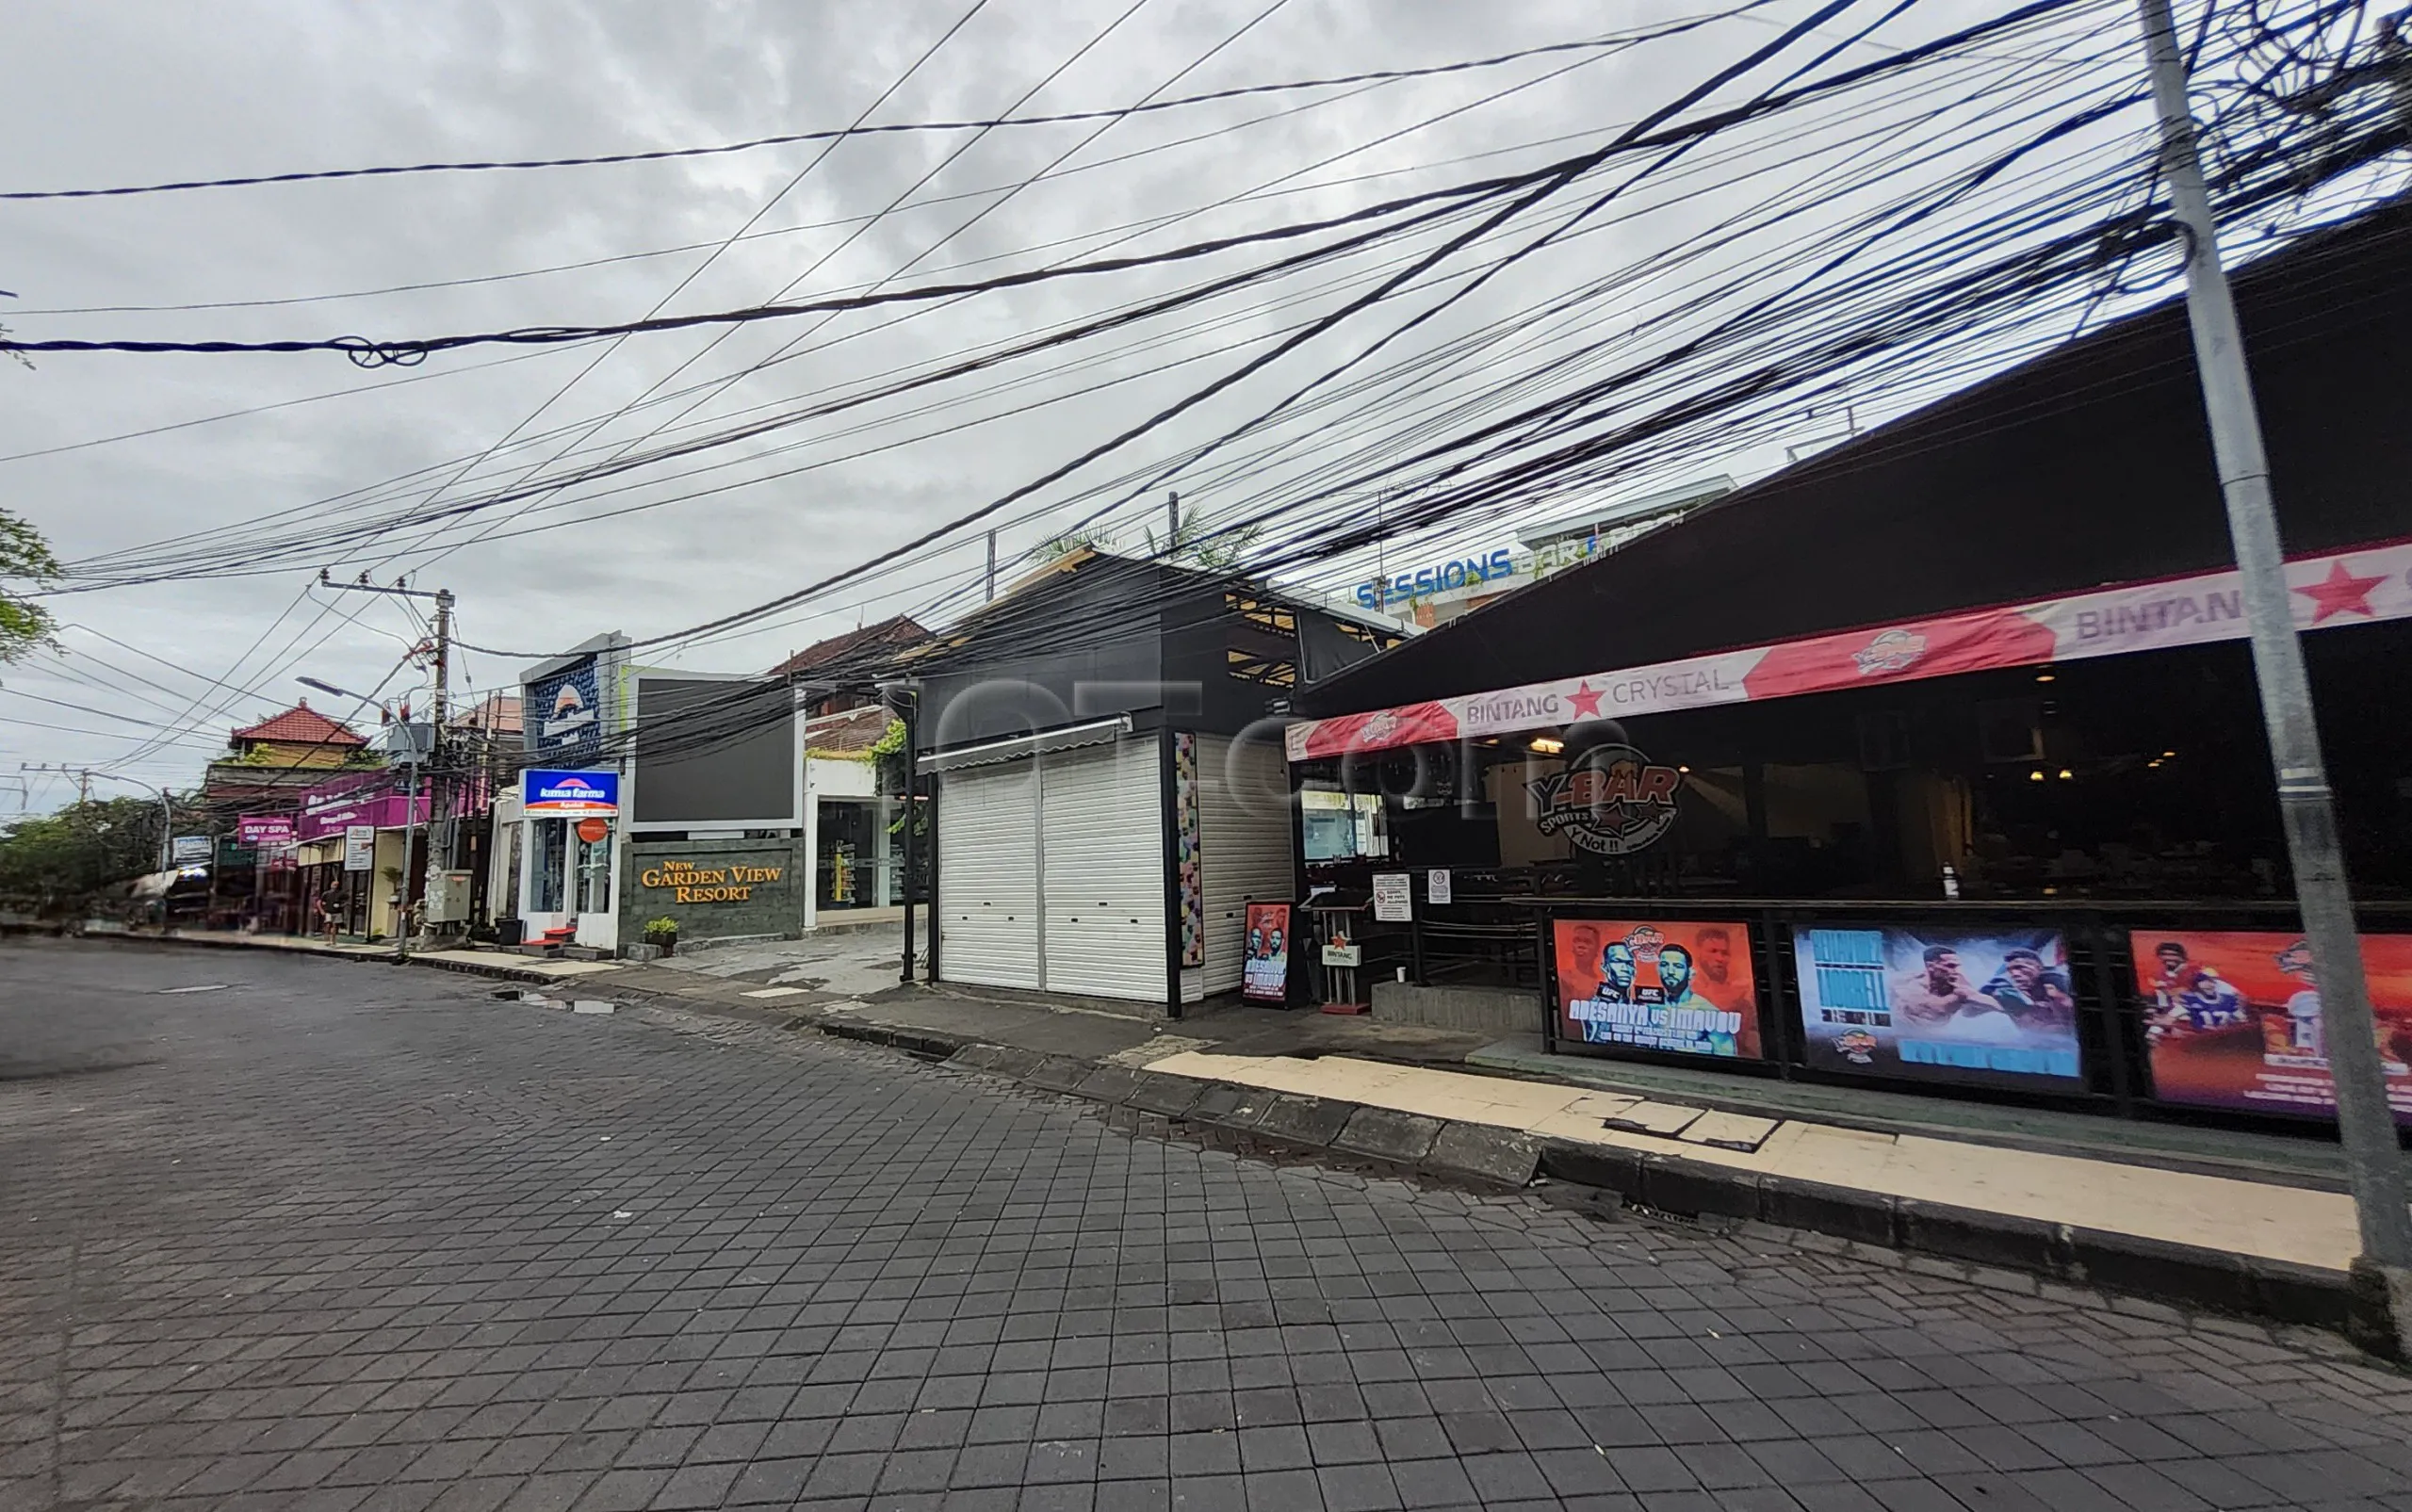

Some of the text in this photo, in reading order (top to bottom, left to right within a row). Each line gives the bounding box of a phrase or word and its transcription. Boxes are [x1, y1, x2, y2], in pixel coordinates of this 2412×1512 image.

[1357, 548, 1513, 610] SESSIONS
[2078, 591, 2241, 640] BINTAN
[1467, 669, 1730, 724] BINTANG CRYSTAL
[540, 788, 606, 799] kimia farma
[1527, 765, 1680, 819] Y-BAR
[245, 825, 289, 834] DAY SPA
[1539, 811, 1590, 834] SPORTS
[1571, 826, 1579, 839] Y
[1580, 834, 1606, 851] Not
[1602, 987, 1621, 999] UFC
[1642, 988, 1659, 997] UFC
